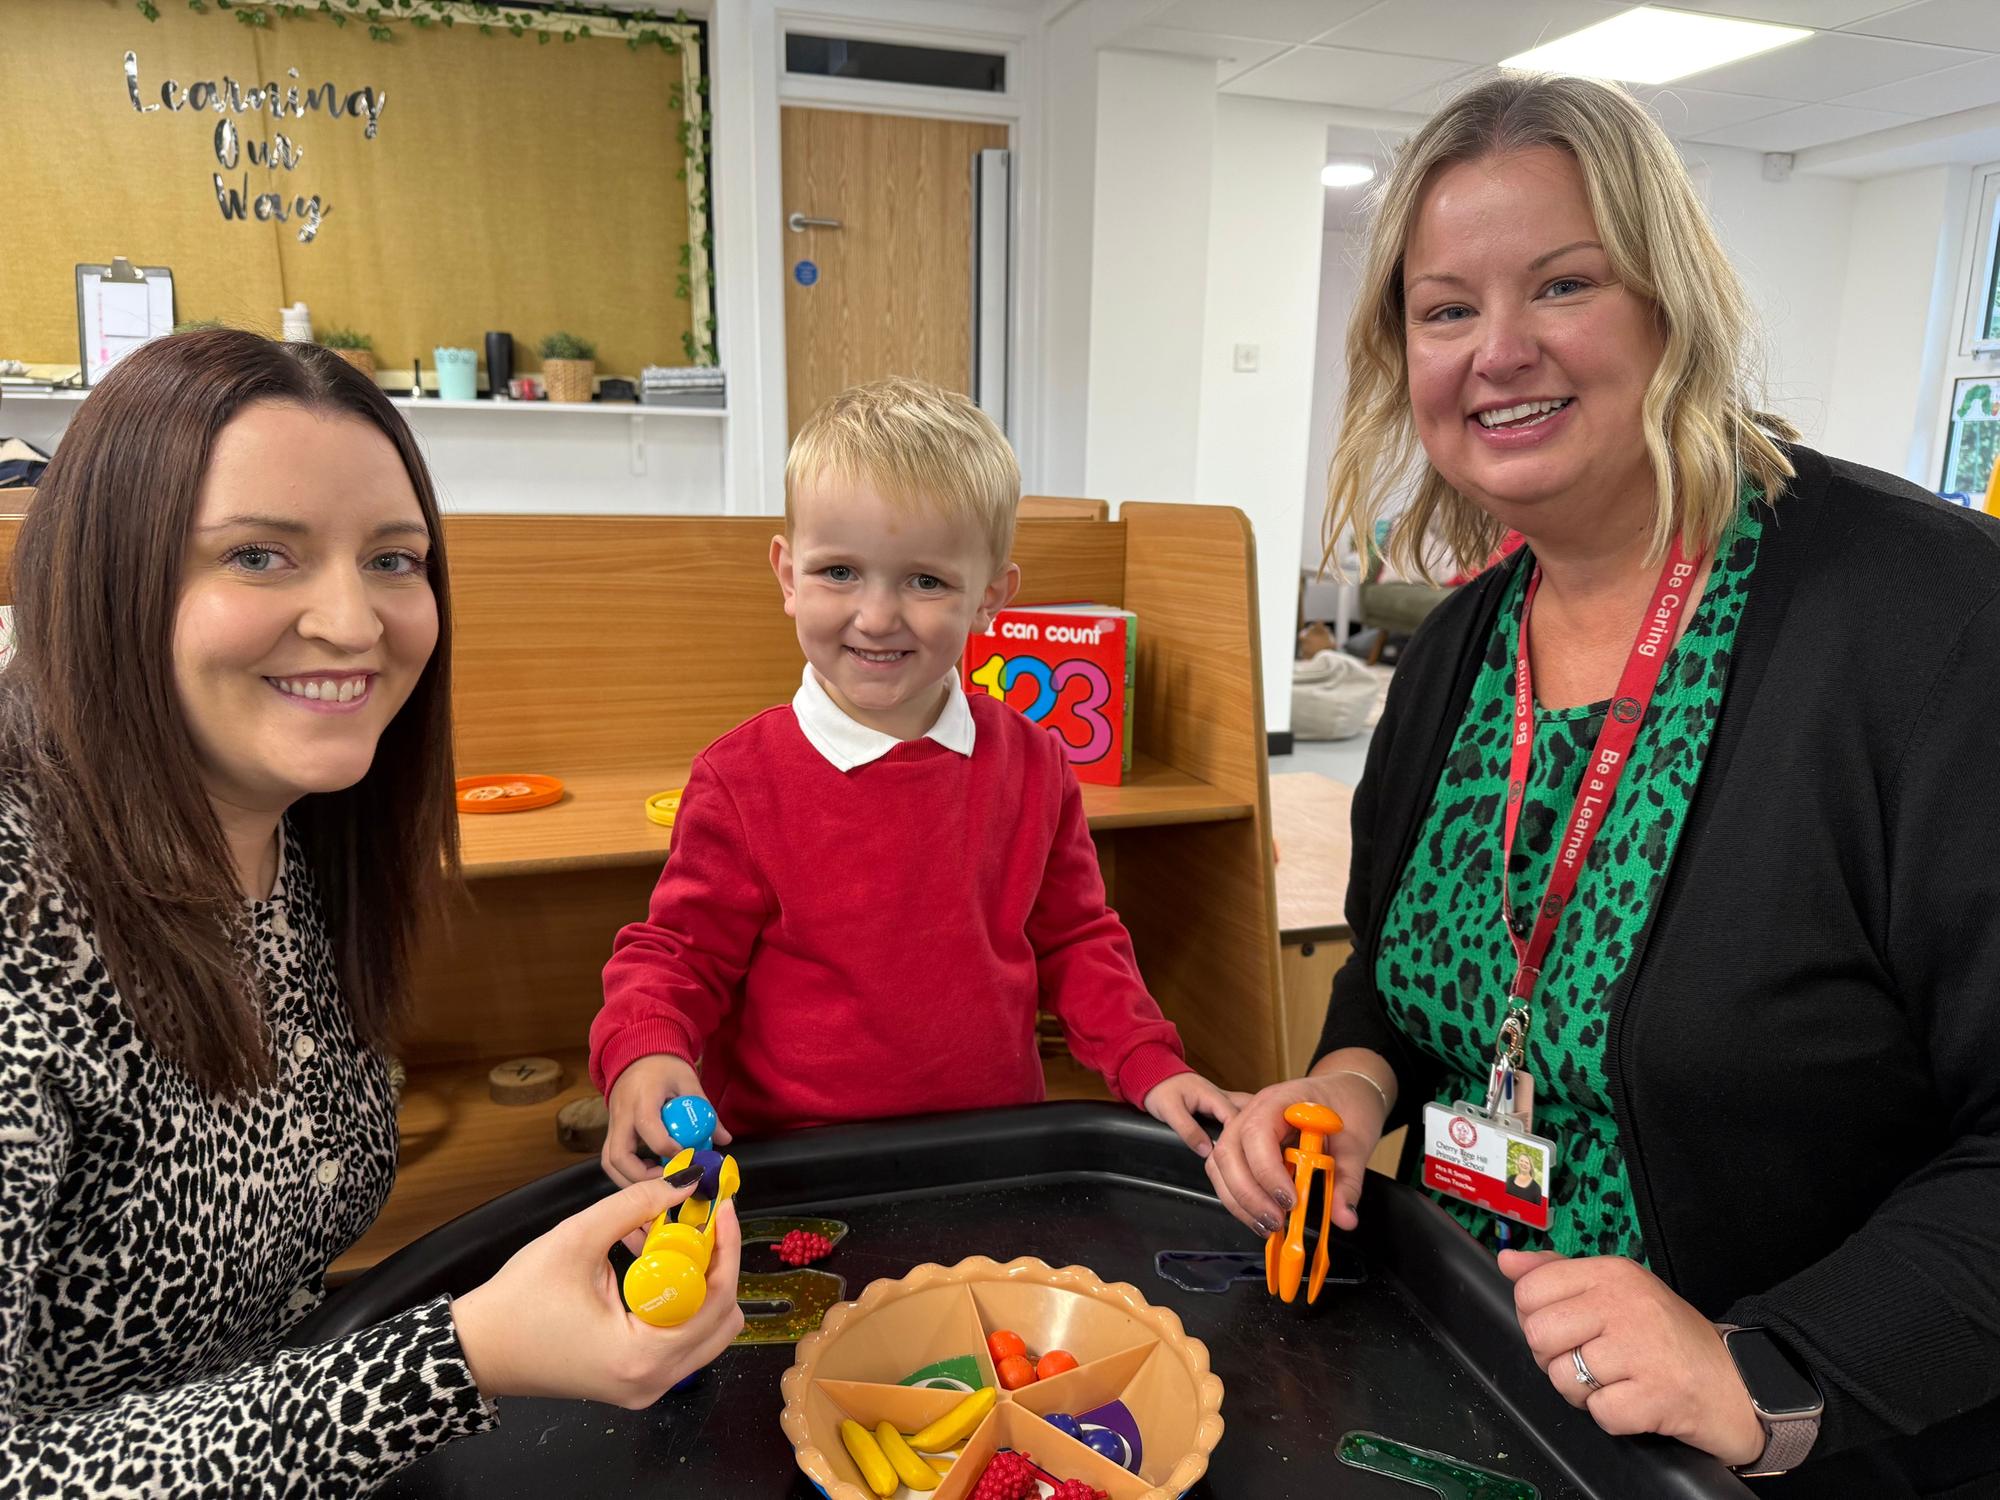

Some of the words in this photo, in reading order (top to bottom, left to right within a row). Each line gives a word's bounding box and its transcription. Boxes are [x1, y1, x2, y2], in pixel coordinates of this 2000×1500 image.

[124, 50, 386, 140] Learning
[214, 118, 304, 170] Our
[213, 172, 333, 243] Way
[1666, 563, 1693, 588] Be
[1001, 621, 1039, 641] can
[1044, 624, 1102, 646] count
[1638, 593, 1680, 657] Caring
[1516, 721, 1528, 746] Be
[1596, 748, 1621, 775] Be
[1589, 778, 1604, 791] a
[1562, 795, 1603, 868] Learner
[1436, 1141, 1457, 1154] Cherry
[1436, 1150, 1460, 1164] Primary
[1462, 1160, 1484, 1171] School
